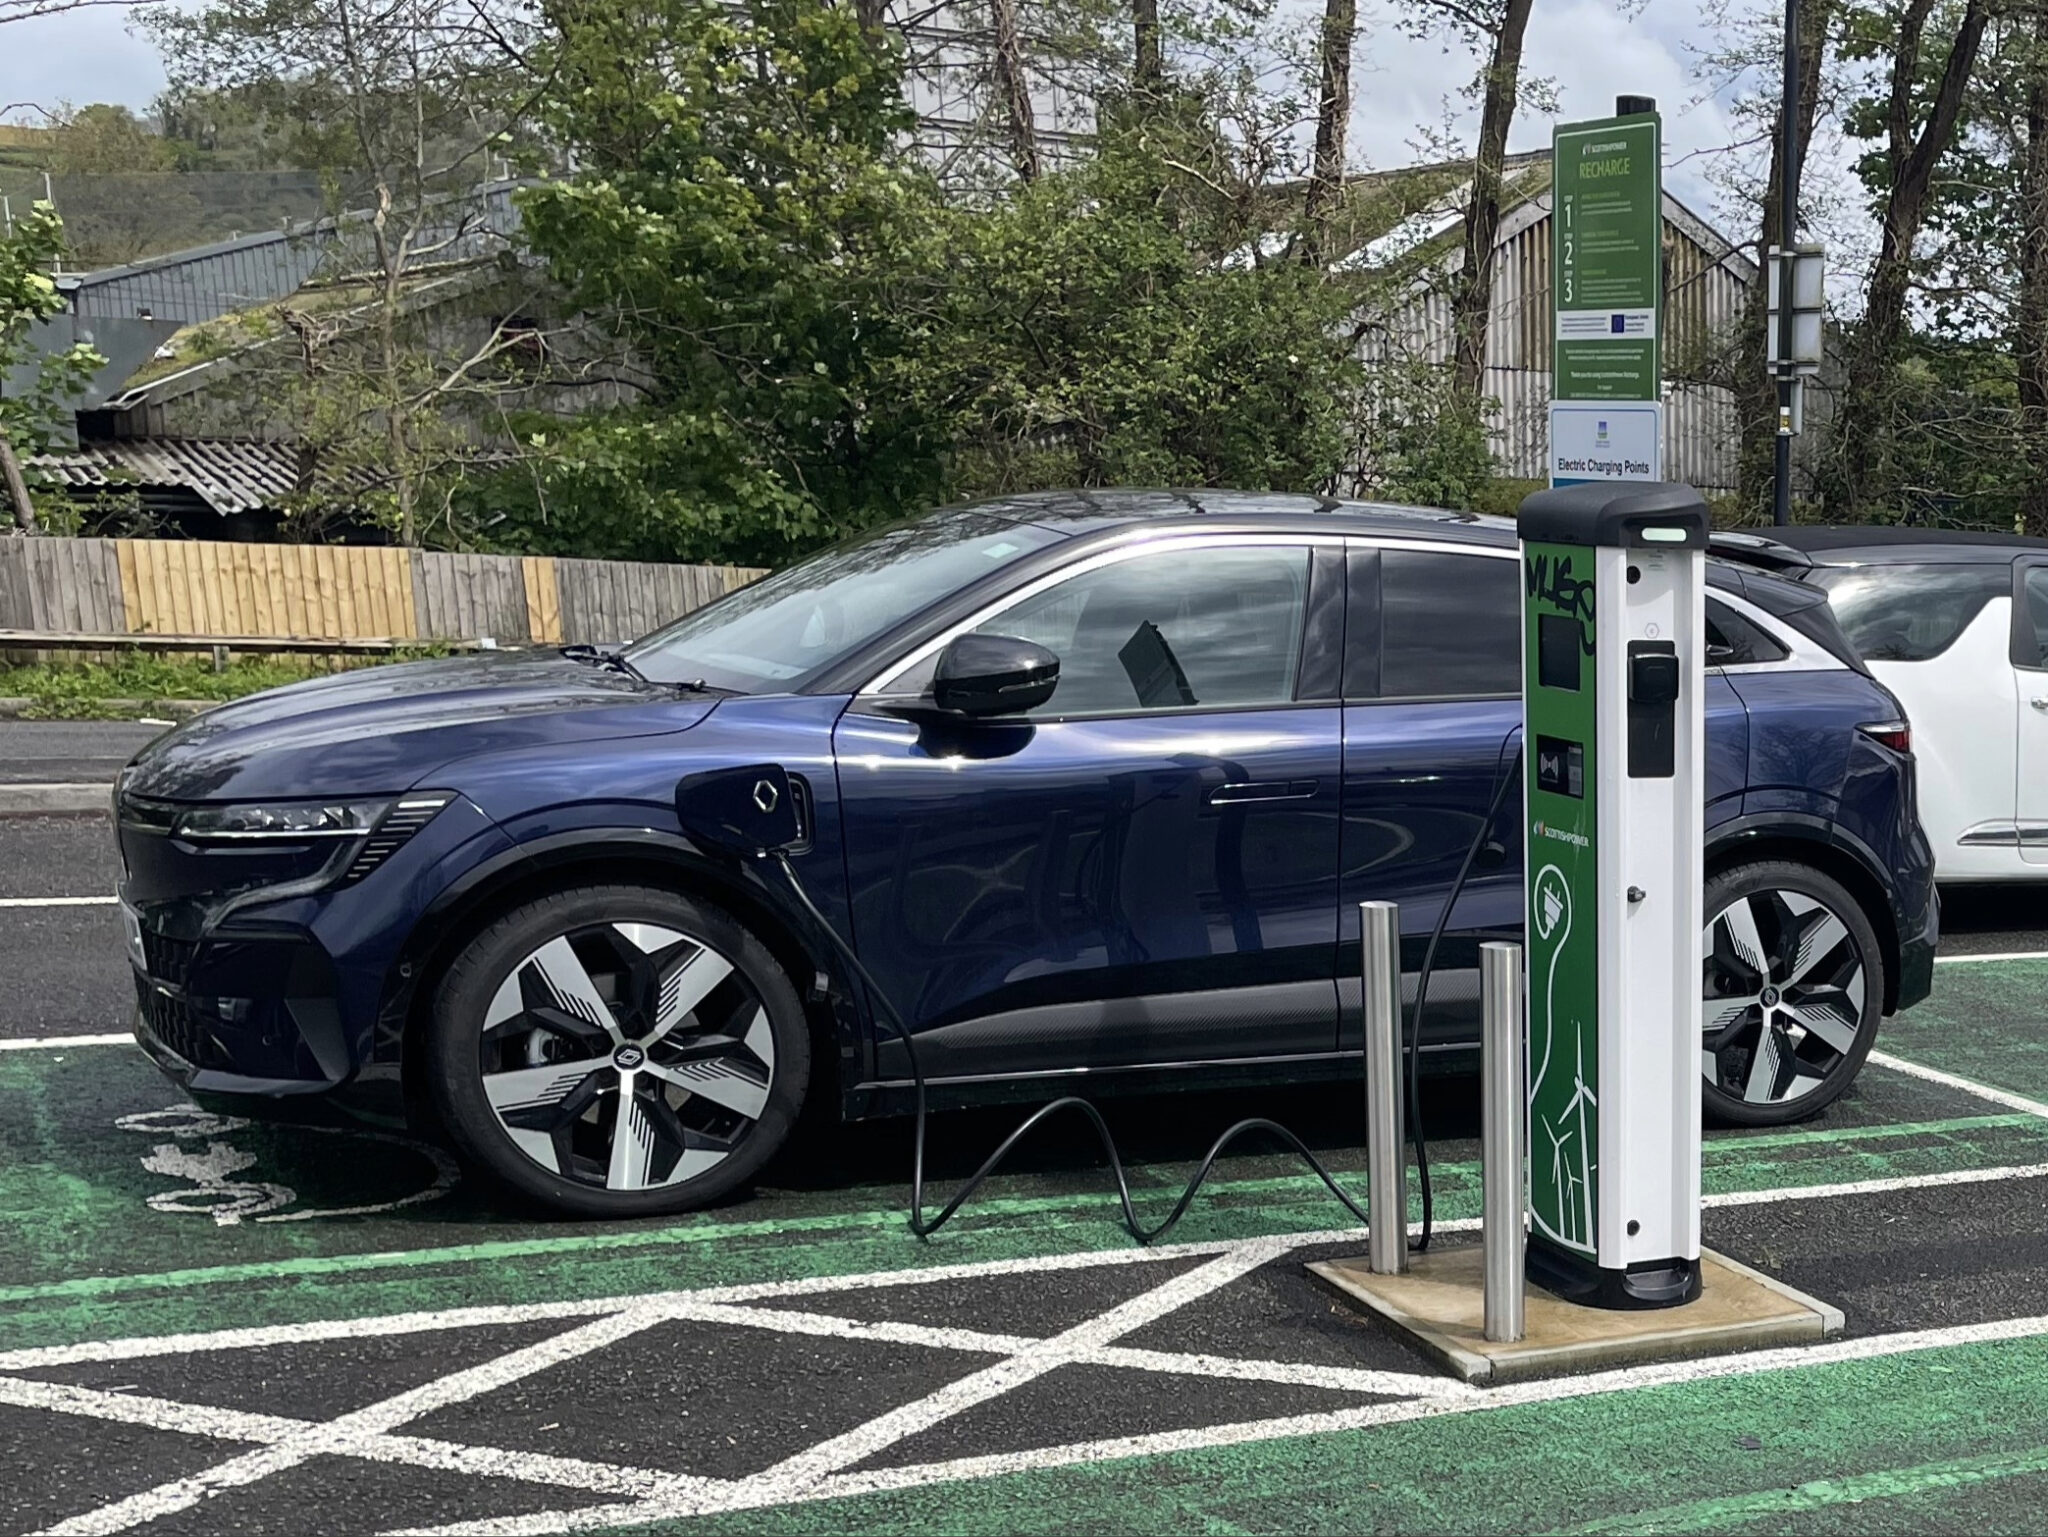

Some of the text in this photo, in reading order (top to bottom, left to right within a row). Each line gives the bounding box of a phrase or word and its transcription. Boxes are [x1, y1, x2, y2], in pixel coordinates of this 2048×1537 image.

[1580, 157, 1630, 179] RECHARGE
[1565, 204, 1571, 228] 1
[1564, 241, 1573, 265] 2
[1564, 279, 1573, 302] 3
[1558, 458, 1649, 476] Electric Charging Points
[1545, 826, 1589, 847] SCOTTISHPOWER
